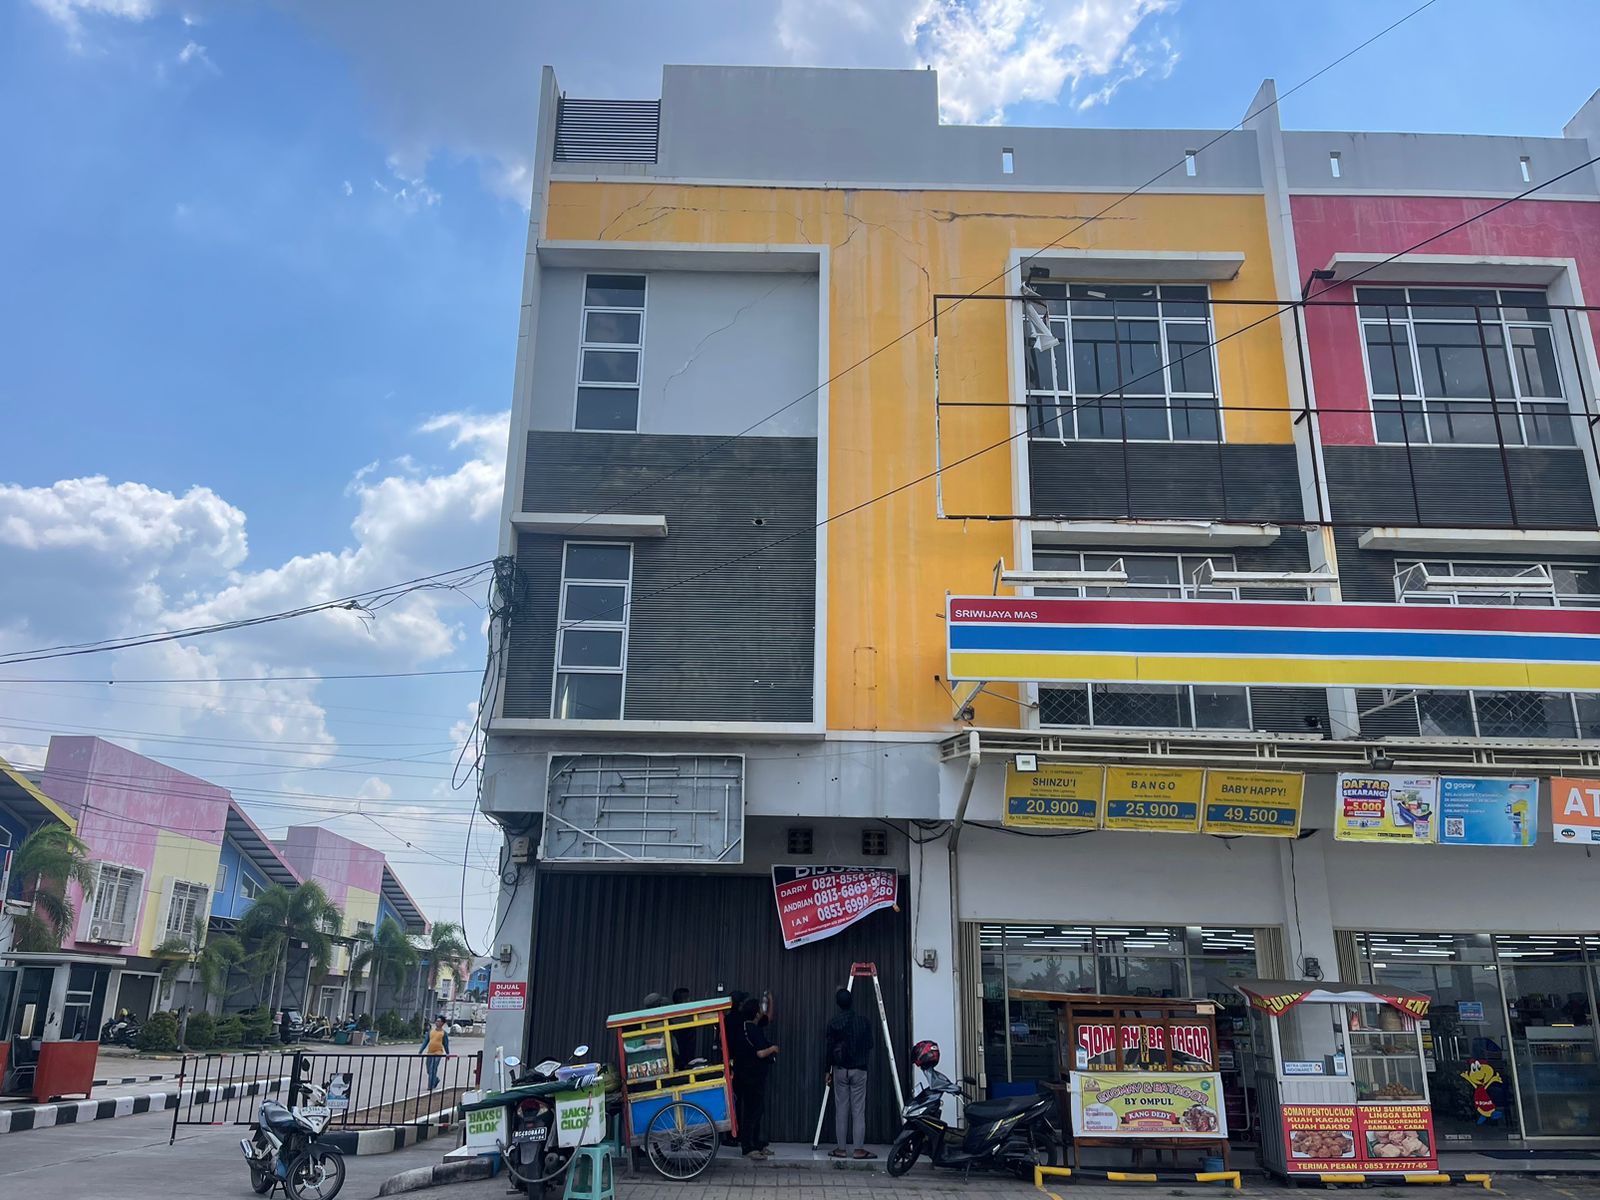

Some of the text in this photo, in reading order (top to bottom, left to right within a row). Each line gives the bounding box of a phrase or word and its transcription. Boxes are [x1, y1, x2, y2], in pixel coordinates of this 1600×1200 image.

[955, 609, 1038, 619] SRIWIJAYA MAS
[1032, 777, 1076, 787] SHINZU'I
[1131, 780, 1176, 790] BANGO
[1343, 780, 1389, 790] DAFTAR
[1221, 784, 1287, 797] BABY HAPPY!
[1343, 789, 1387, 798] SEKARANG!
[1026, 799, 1079, 814] 20.900
[1126, 802, 1178, 816] 25.900
[1352, 802, 1382, 811] 5.000
[1224, 807, 1278, 822] 49.500
[780, 884, 808, 897] DARRY
[783, 897, 814, 913] ANDRIAN
[1140, 1098, 1175, 1106] OMPUL
[468, 1107, 503, 1122] BAKSO
[561, 1105, 594, 1120] BAKSO
[1129, 1111, 1172, 1119] KANG DEDY
[469, 1121, 499, 1135] CILOK
[561, 1117, 591, 1130] CILOK
